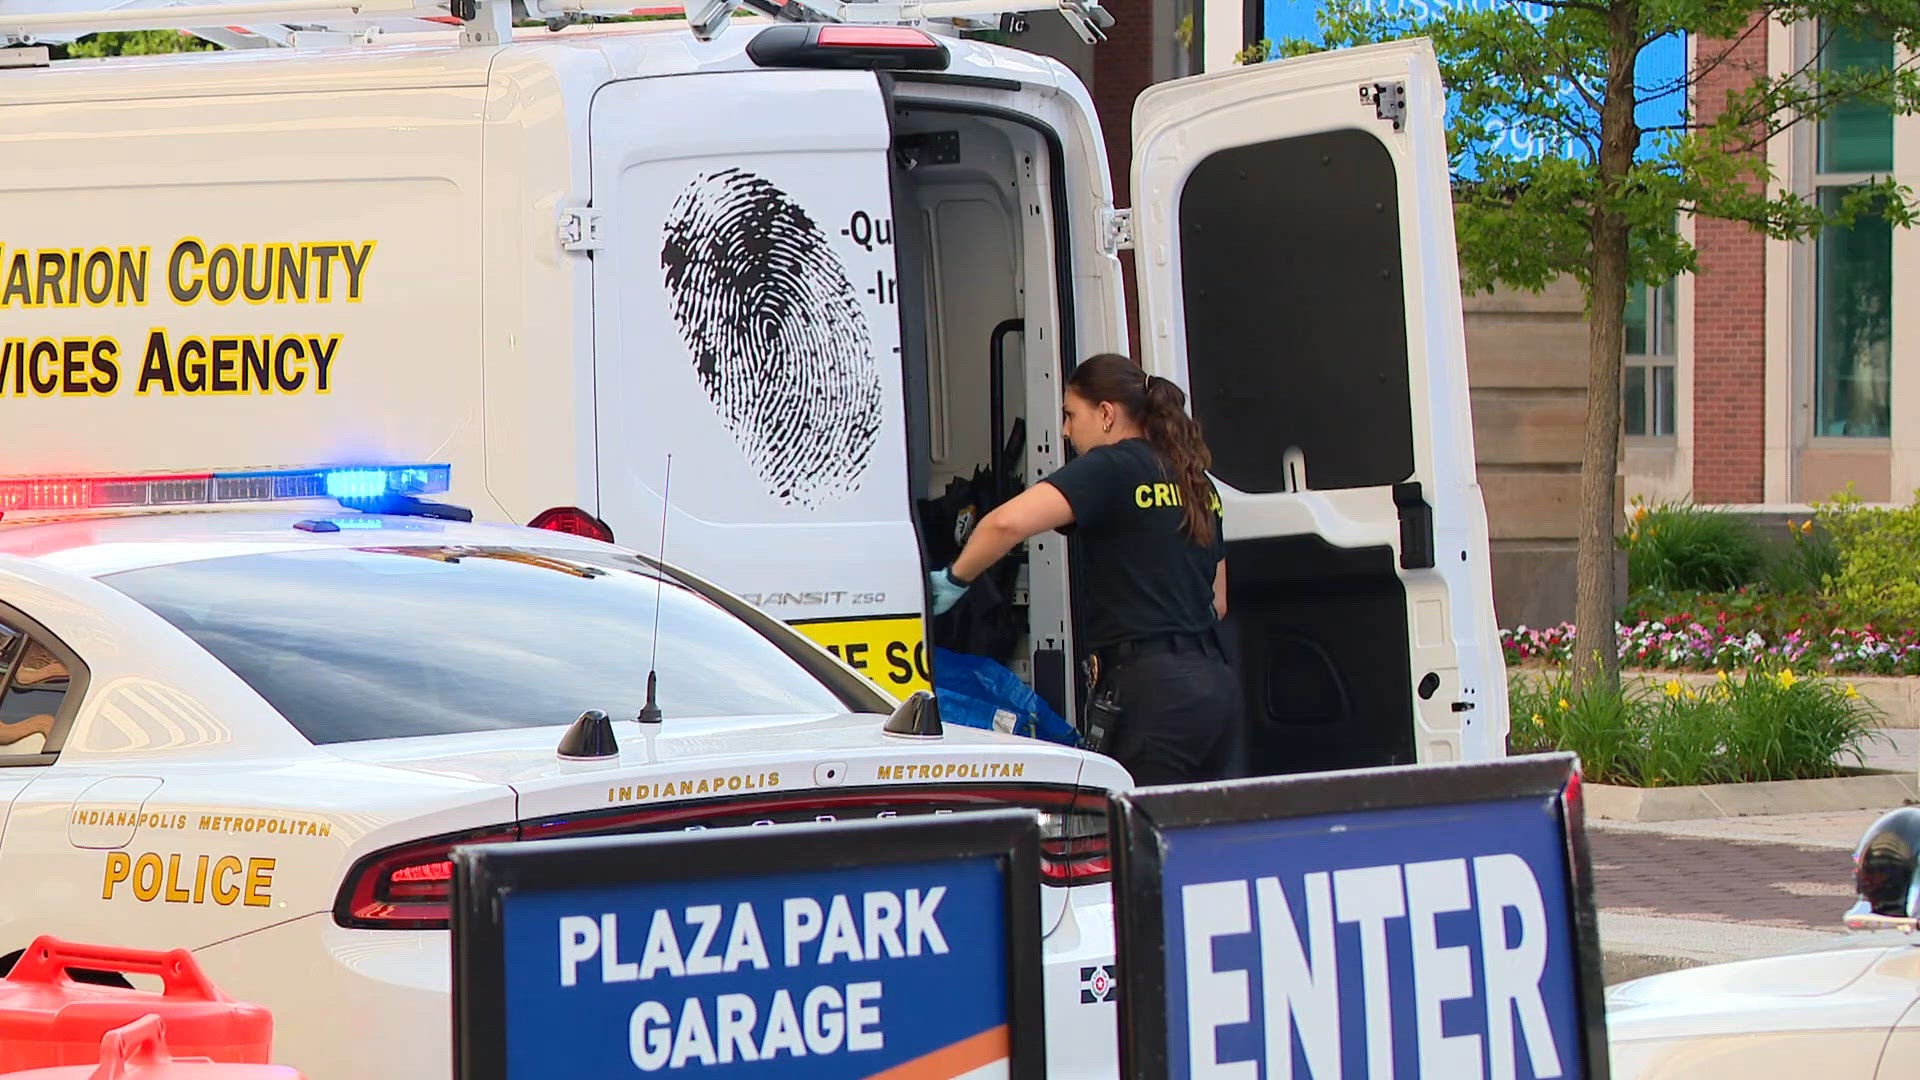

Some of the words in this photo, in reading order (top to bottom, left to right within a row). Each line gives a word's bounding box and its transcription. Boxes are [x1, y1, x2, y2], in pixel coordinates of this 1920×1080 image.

[0, 242, 152, 308] ARION
[166, 236, 378, 306] COUNTY
[135, 327, 344, 397] AGENCY
[608, 772, 781, 802] INDIANAPOLIS
[877, 763, 1025, 780] METROPOLITAN
[71, 809, 188, 830] INDIANAPOLIS
[198, 815, 332, 838] METROPOLITAN
[102, 851, 277, 908] POLICE
[558, 901, 771, 987] PLAZA
[783, 886, 950, 967] PARK
[1182, 853, 1564, 1080] ENTER
[628, 981, 885, 1073] GARAGE
